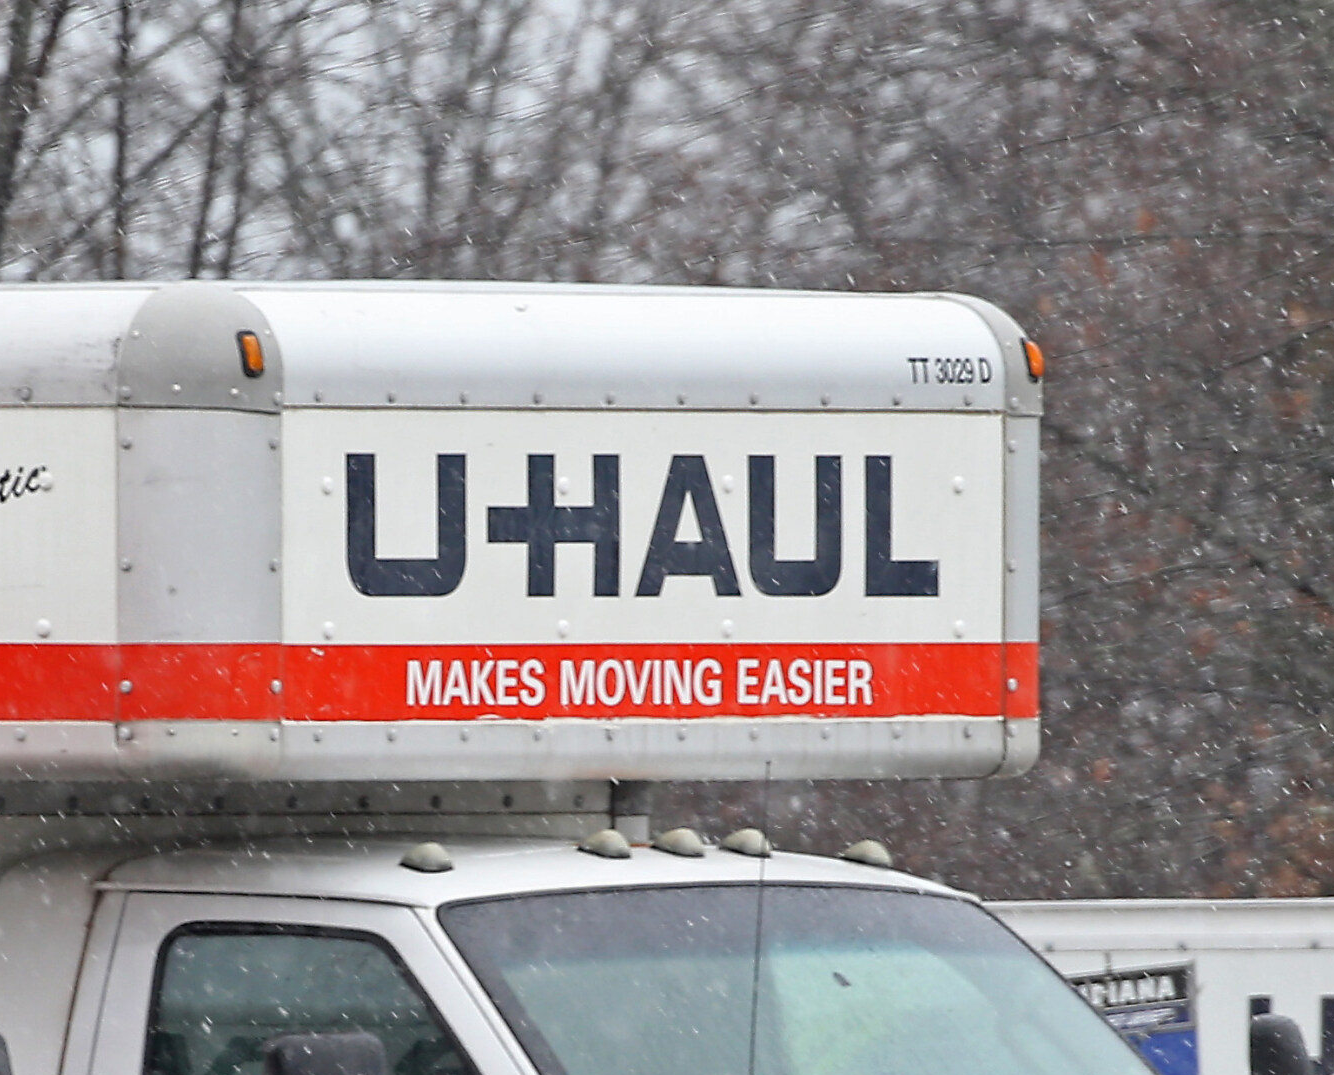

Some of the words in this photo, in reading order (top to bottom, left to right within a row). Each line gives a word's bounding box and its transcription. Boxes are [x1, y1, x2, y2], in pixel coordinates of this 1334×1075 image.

[907, 357, 929, 384] TT
[935, 358, 974, 384] 3029
[979, 357, 992, 384] D
[344, 452, 940, 598] U-HAUL
[406, 658, 546, 706] MAKES
[561, 659, 723, 706] MOVING
[737, 658, 873, 706] EASIER
